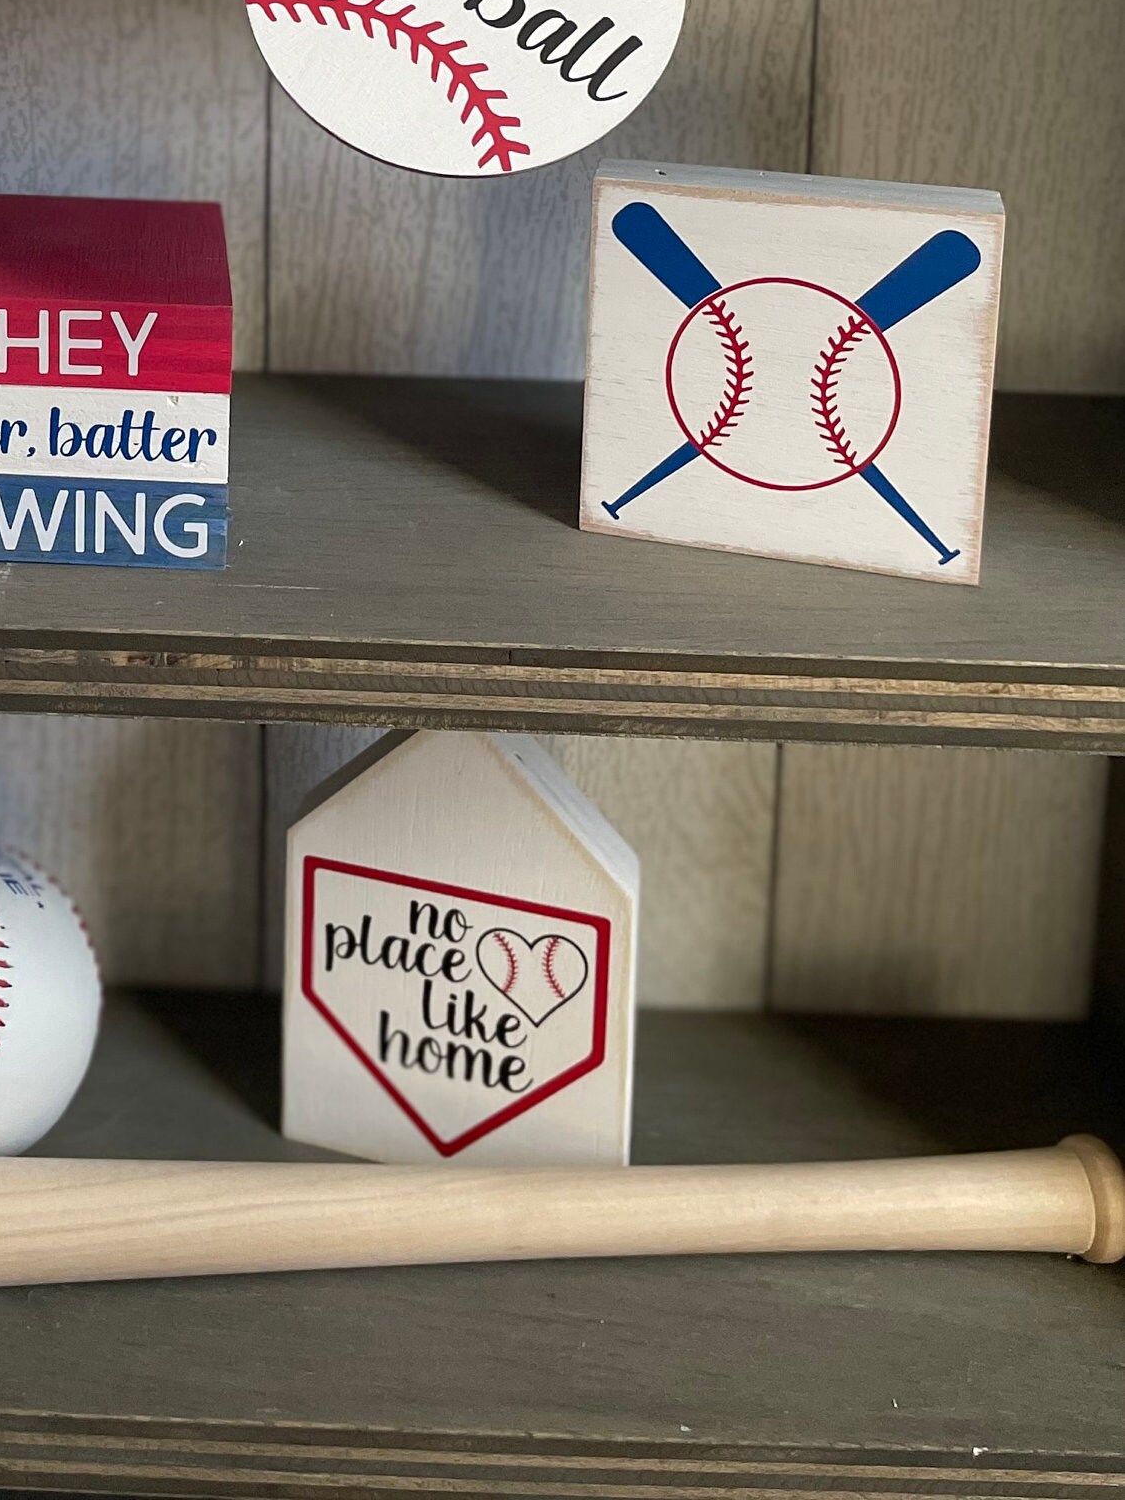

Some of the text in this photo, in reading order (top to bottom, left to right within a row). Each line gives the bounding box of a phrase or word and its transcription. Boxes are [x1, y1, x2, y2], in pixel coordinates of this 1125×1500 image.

[49, 406, 218, 464] batter
[324, 913, 473, 984] place
[408, 899, 474, 943] no
[421, 978, 528, 1049] like
[378, 1009, 534, 1094] home
